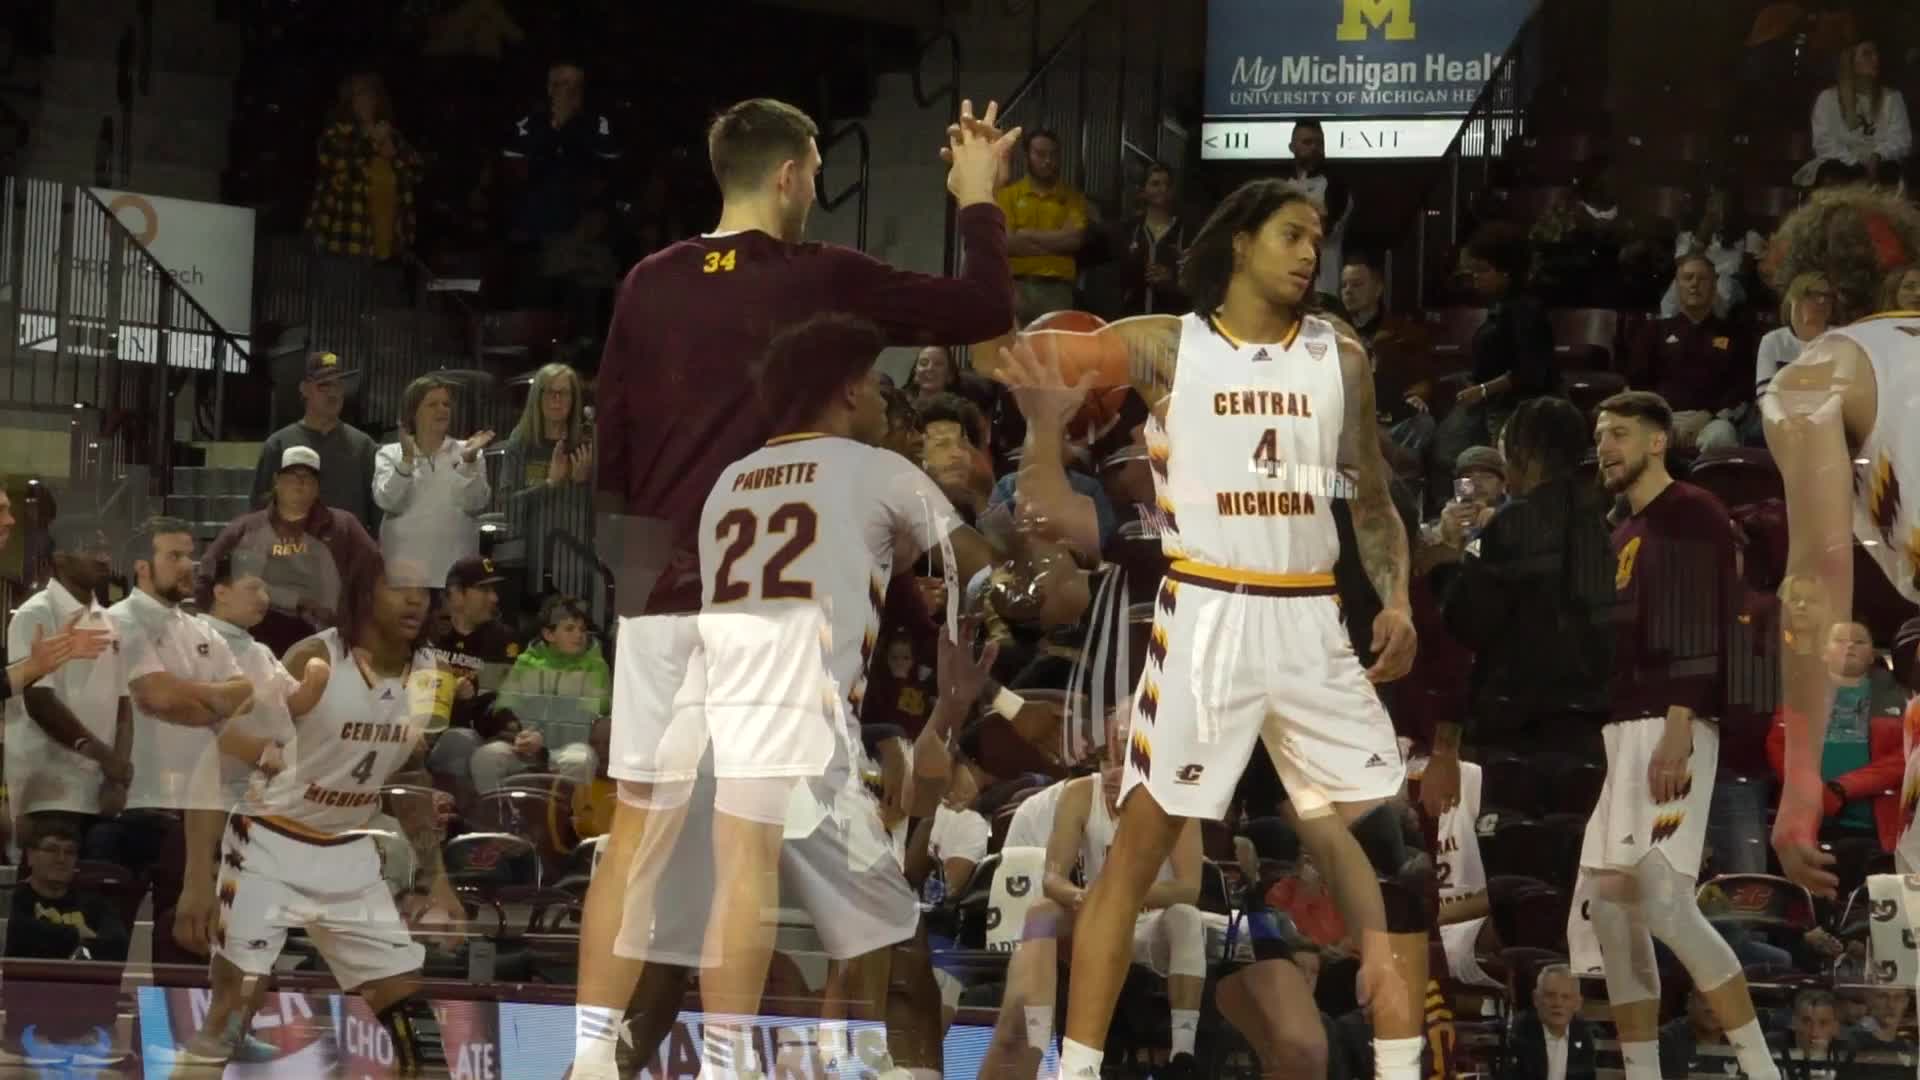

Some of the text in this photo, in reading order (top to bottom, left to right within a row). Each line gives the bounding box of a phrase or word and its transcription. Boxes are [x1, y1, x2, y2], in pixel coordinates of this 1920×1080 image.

[1336, 0, 1415, 41] M
[1231, 56, 1277, 92] My
[1281, 55, 1417, 90] Michigan
[1230, 91, 1333, 105] UNIVERSITY
[1336, 91, 1356, 105] OF
[1360, 89, 1448, 105] MICHIGAN
[703, 249, 737, 273] 34
[1213, 390, 1313, 418] CENTRAL
[1252, 428, 1280, 478] 4
[1216, 491, 1316, 517] MICHIGAN
[712, 502, 818, 604] 22
[341, 721, 409, 743] CENTRAL
[351, 750, 378, 785] 4
[304, 783, 379, 808] MICHIGA
